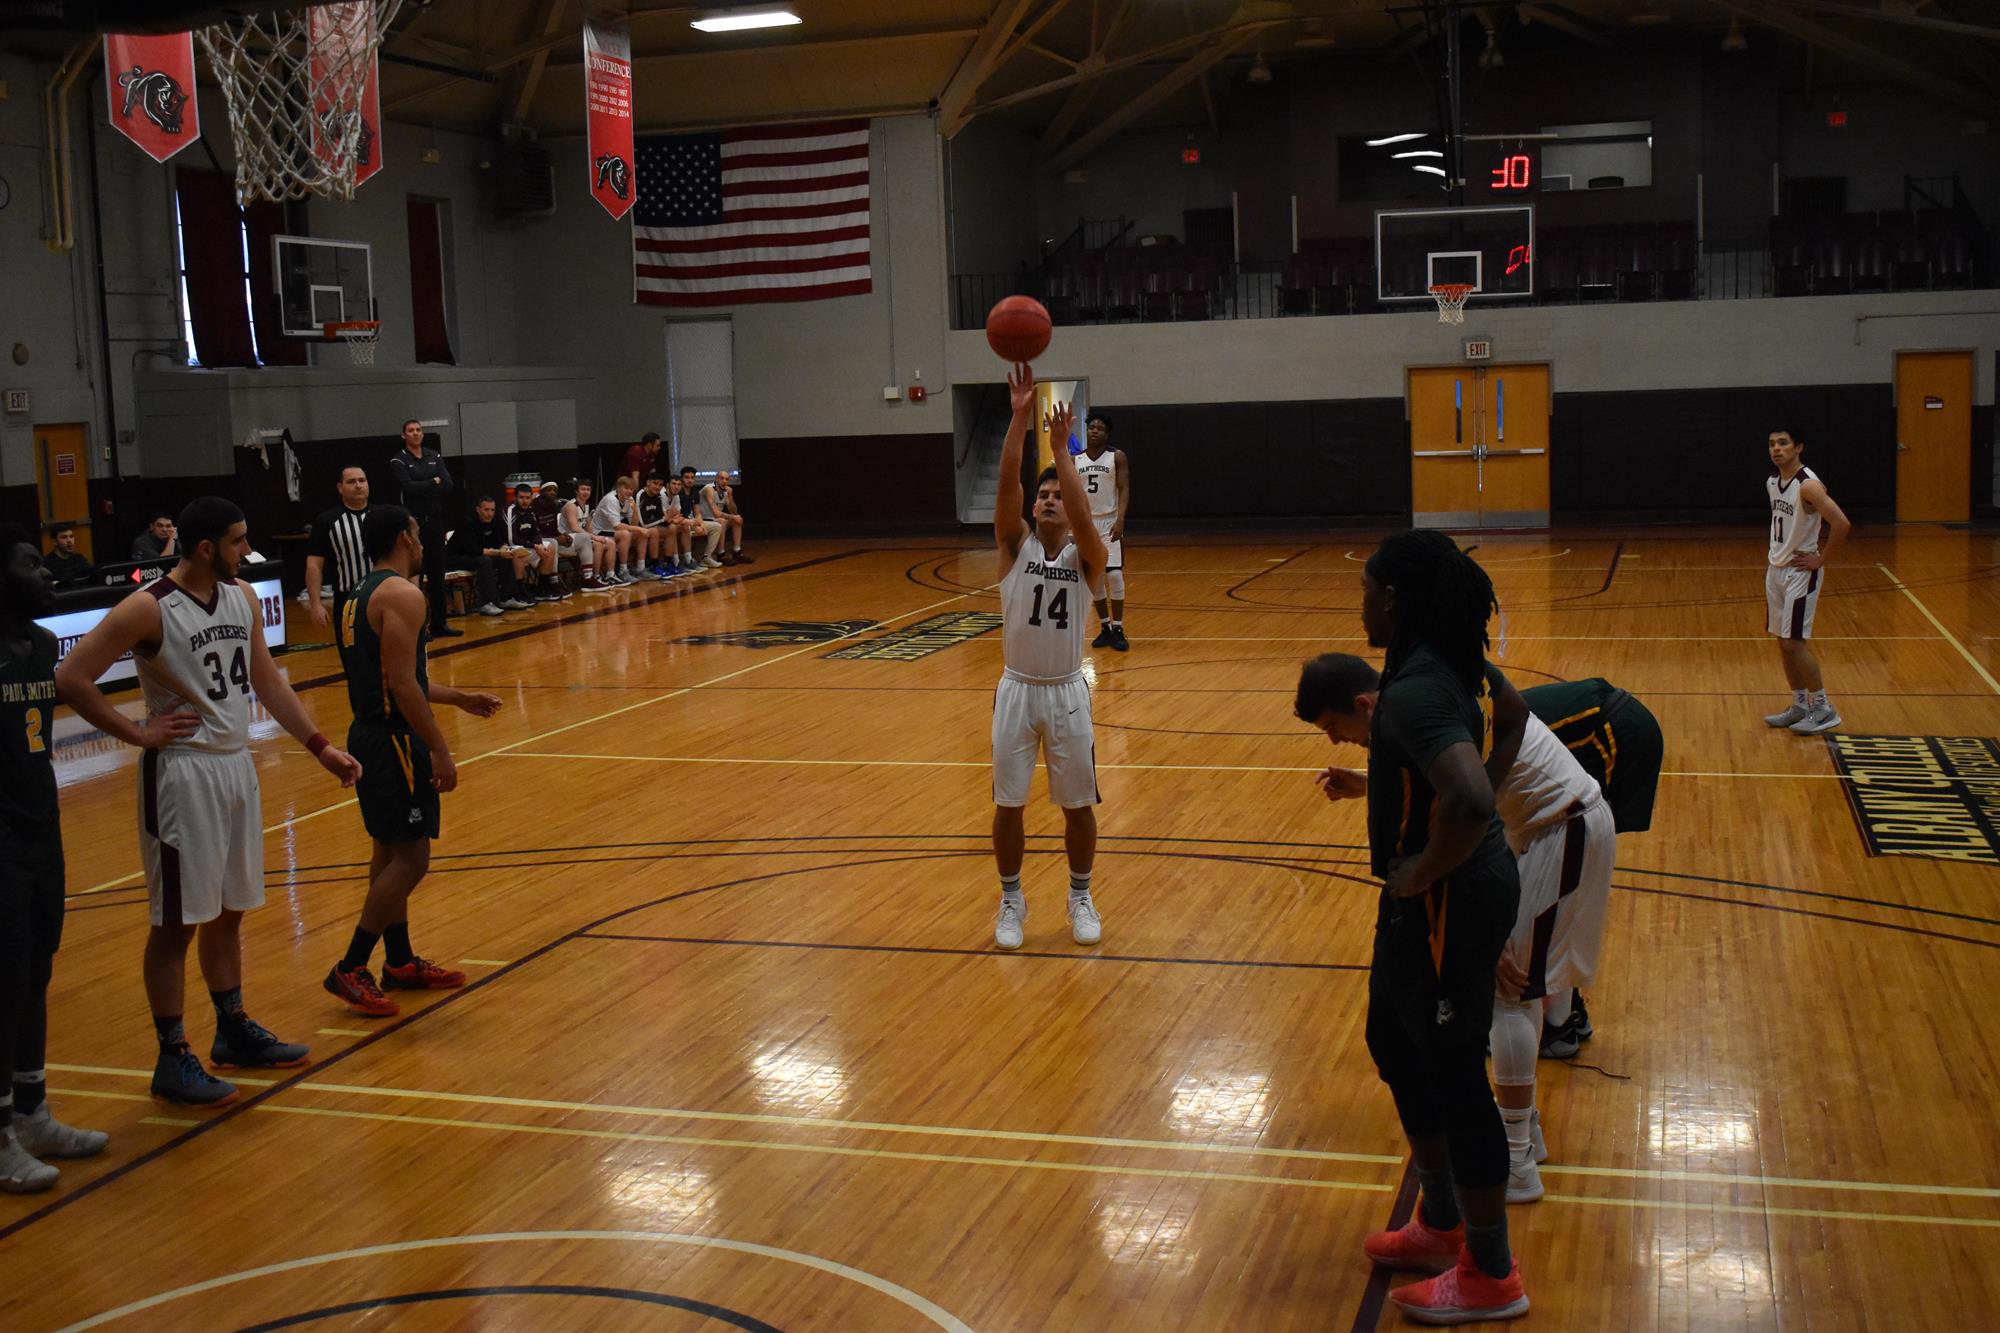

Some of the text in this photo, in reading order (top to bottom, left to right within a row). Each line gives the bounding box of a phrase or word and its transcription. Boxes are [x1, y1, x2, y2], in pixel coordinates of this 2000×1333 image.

[1470, 343, 1486, 357] EXIT
[1078, 465, 1110, 475] PANTHERS
[1087, 474, 1099, 494] 5
[141, 568, 157, 581] POSS
[1025, 561, 1079, 583] PANTHERS
[1029, 583, 1069, 629] 14
[190, 624, 249, 652] PANTHERS
[203, 645, 250, 701] 34
[2, 682, 26, 703] PAUL
[25, 707, 46, 753] 2
